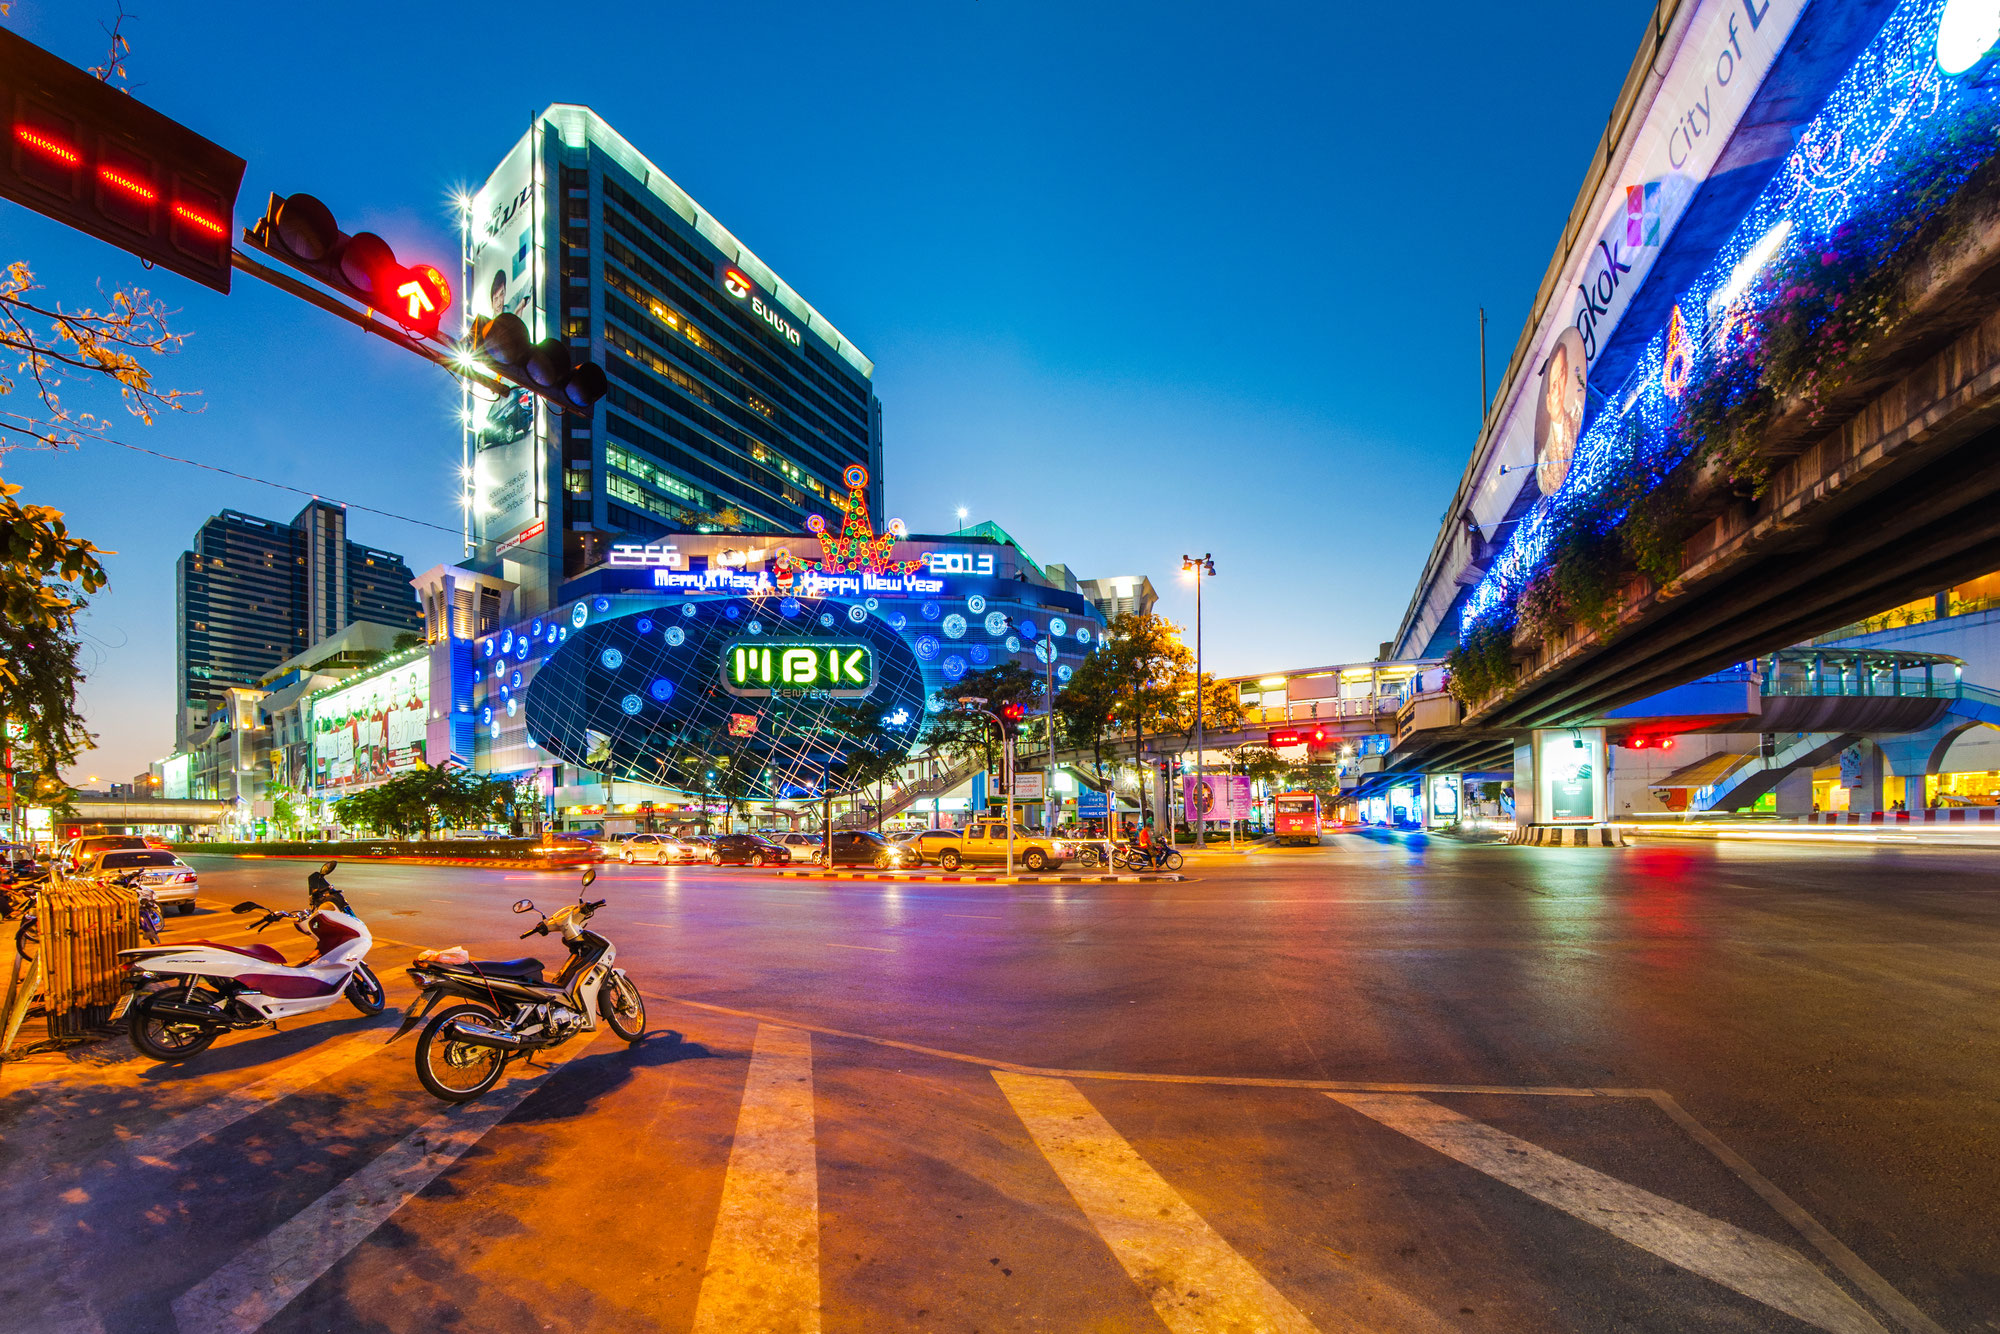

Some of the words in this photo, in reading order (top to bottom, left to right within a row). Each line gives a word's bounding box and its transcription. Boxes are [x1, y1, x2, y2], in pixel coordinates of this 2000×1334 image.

[1669, 85, 1710, 170] City
[1716, 12, 1742, 87] of
[751, 296, 800, 346] ธนชาต
[610, 544, 681, 566] 2556
[930, 553, 993, 575] 2013
[654, 569, 705, 591] Merry
[863, 574, 901, 590] New
[904, 575, 943, 592] Year
[736, 649, 864, 682] MBK
[772, 688, 830, 699] CENTER
